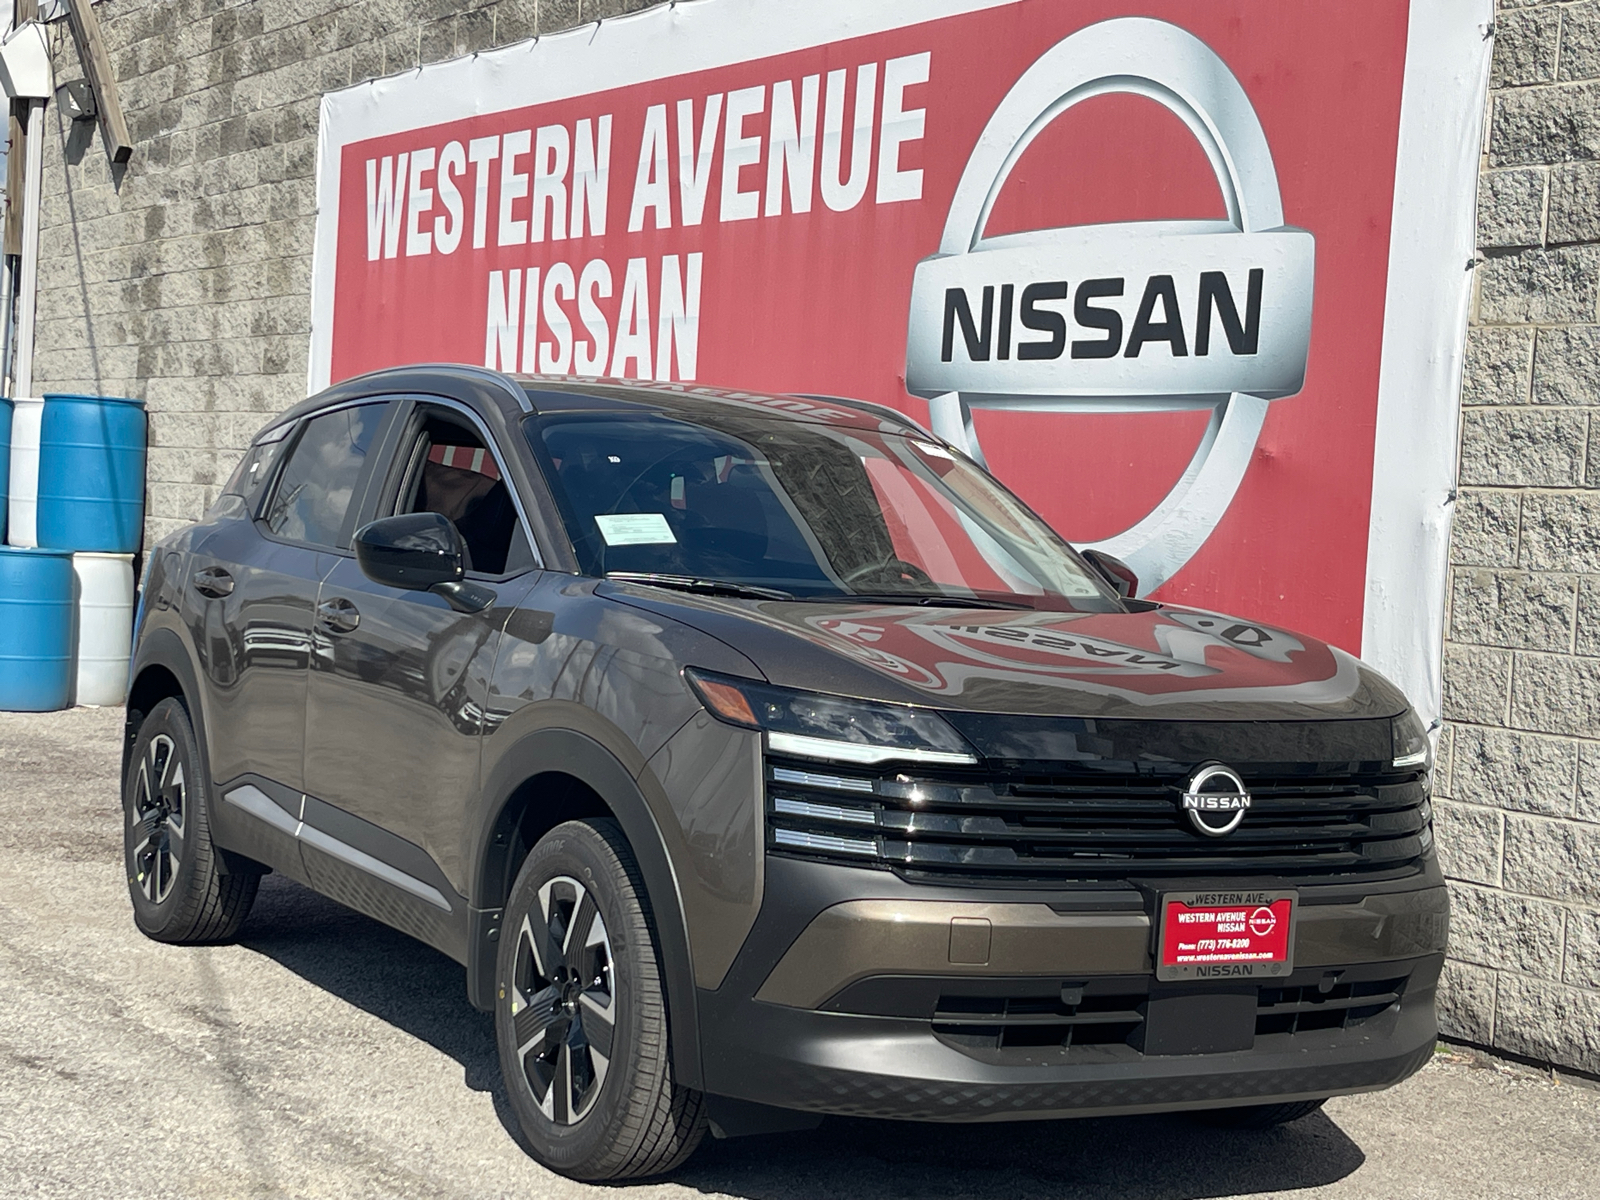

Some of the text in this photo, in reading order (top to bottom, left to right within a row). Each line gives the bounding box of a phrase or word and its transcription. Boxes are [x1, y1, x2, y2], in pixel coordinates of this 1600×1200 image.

[365, 51, 931, 261] WESTERN AVENUE
[484, 252, 703, 380] NISSAN
[941, 268, 1264, 362] NISSAN
[1184, 795, 1251, 809] NISSAN
[1195, 893, 1265, 905] WESTERN AVE
[1178, 912, 1246, 924] WESTERN AVENUE
[1217, 922, 1246, 933] NISSAN
[1197, 939, 1216, 952] (773)
[1196, 965, 1253, 977] NISSAN
